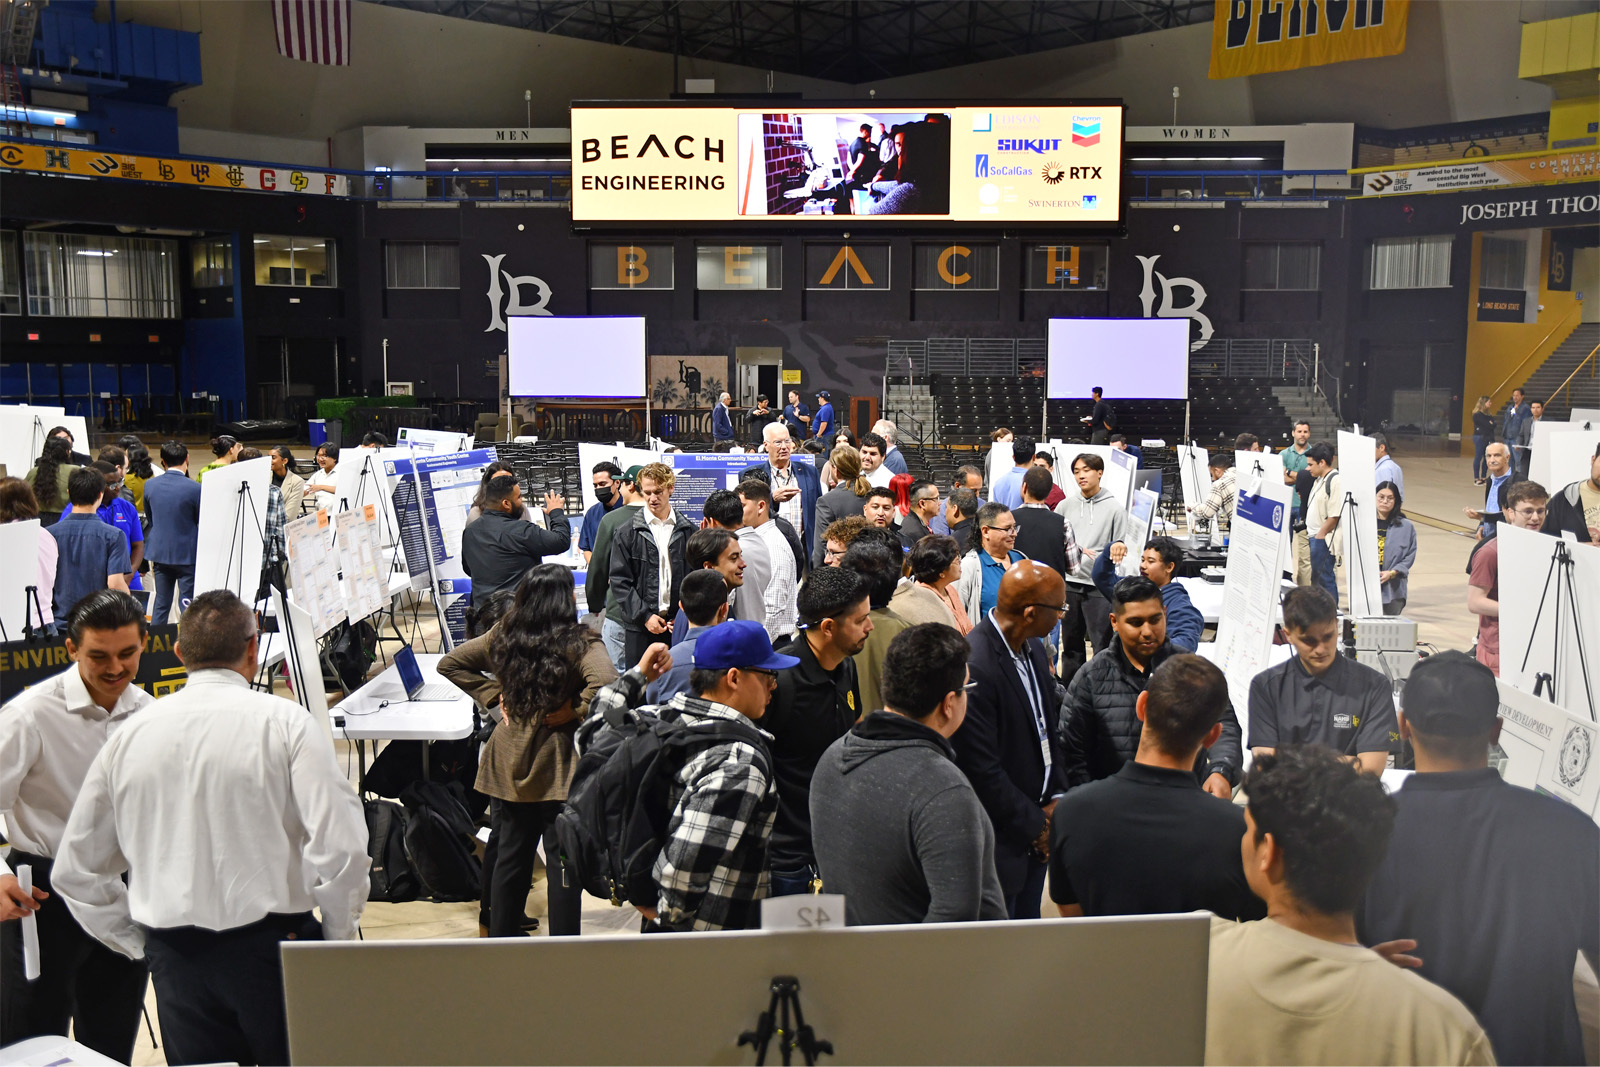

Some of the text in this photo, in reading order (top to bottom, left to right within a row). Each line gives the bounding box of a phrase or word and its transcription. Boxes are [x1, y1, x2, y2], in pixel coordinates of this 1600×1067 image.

[496, 131, 529, 141] MEN
[1163, 128, 1231, 139] WOMEN
[582, 134, 724, 163] BEACH
[997, 139, 1062, 154] SUKUT
[121, 163, 136, 171] BIG
[1530, 156, 1600, 169] COMMISS
[121, 170, 143, 179] WEST
[990, 166, 1033, 176] SoCalGas
[1070, 166, 1102, 179] RTX
[1417, 169, 1442, 177] Awarded
[582, 175, 725, 190] ENGINEERING
[1427, 174, 1458, 182] successful
[324, 174, 336, 195] F
[1028, 199, 1081, 208] SWINERTON
[1460, 195, 1600, 225] JOSEPH THO
[1494, 302, 1507, 310] BEACH
[1508, 303, 1520, 311] STATE
[1512, 709, 1554, 739] DEVELOPMENT
